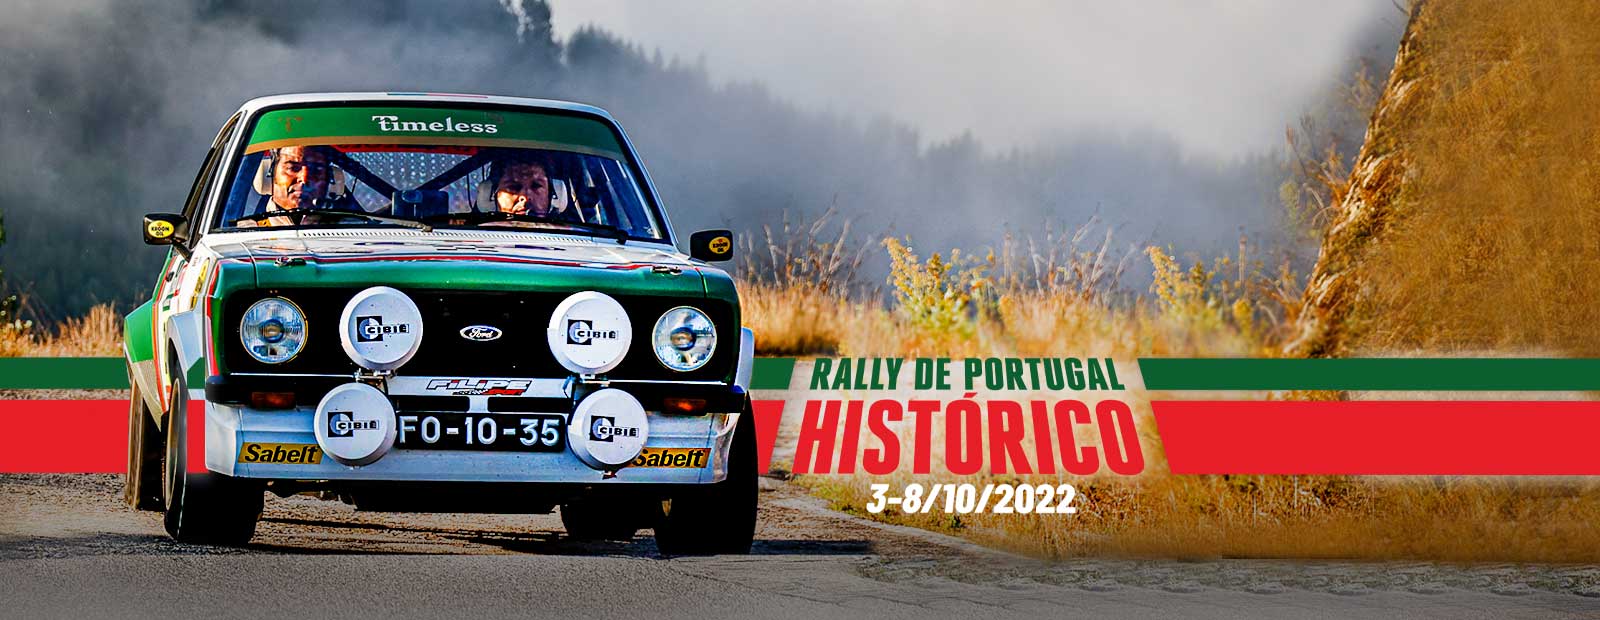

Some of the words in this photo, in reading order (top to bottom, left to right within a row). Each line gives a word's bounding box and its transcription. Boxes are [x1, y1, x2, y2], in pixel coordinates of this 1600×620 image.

[371, 115, 498, 133] Timeless
[469, 327, 494, 338] Ford
[399, 415, 560, 446] FO-10-35
[244, 443, 318, 463] Sabelt
